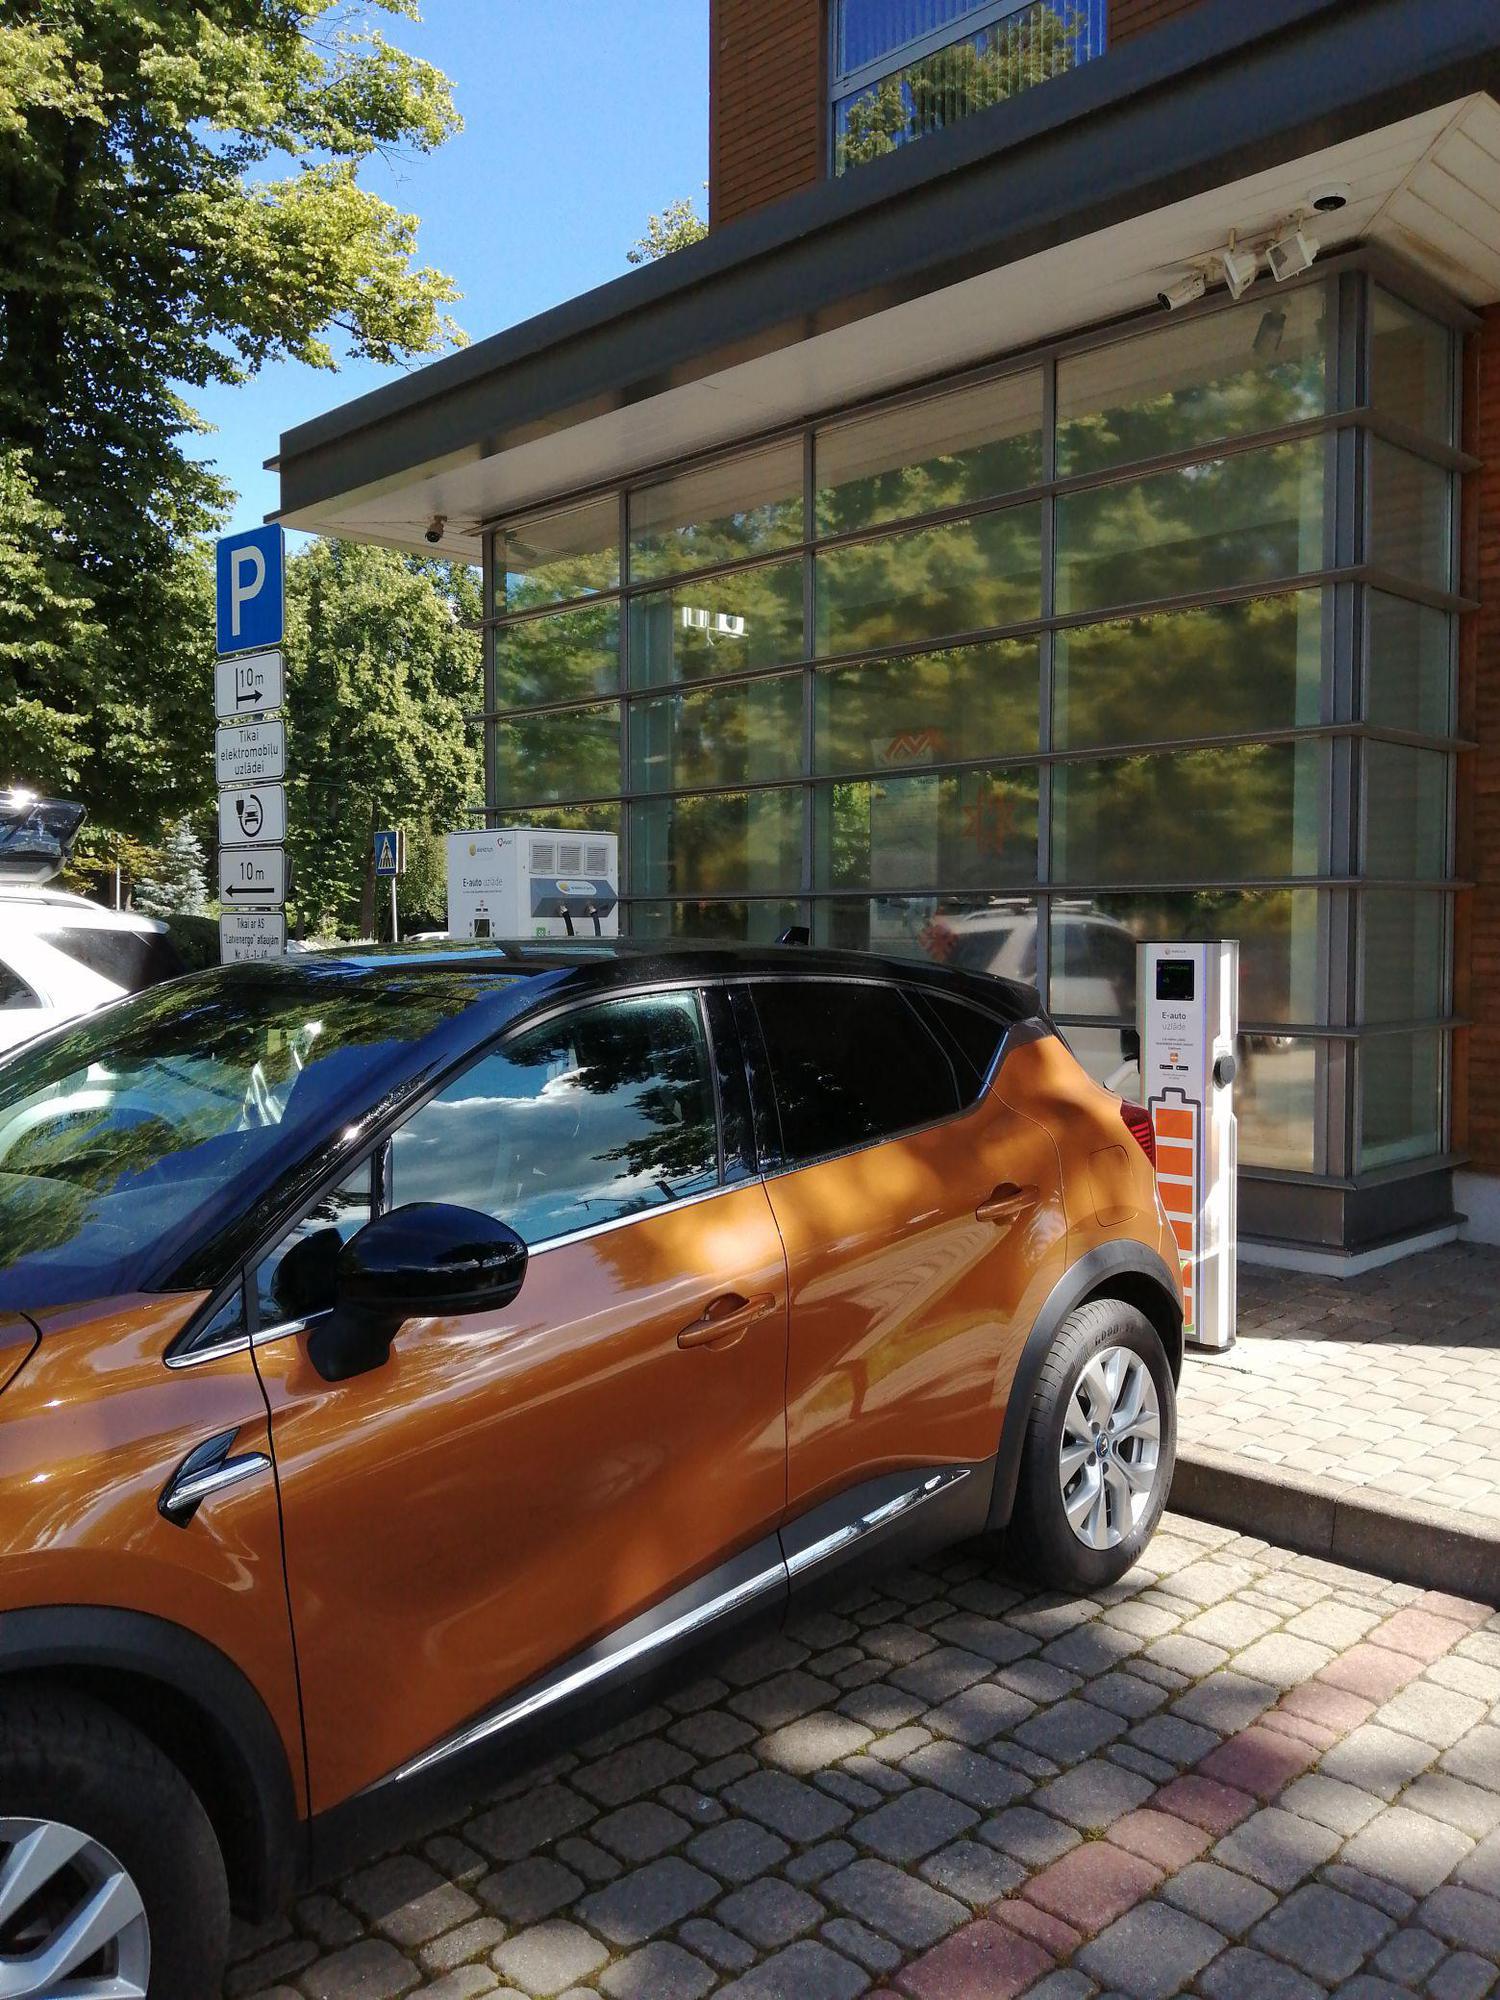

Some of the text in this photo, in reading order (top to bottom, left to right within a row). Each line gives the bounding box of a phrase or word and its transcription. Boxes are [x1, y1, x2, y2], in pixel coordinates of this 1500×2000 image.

[231, 545, 266, 637] P
[239, 728, 259, 743] Tikai
[234, 760, 265, 775] uzlādei
[462, 878, 483, 888] E-auto
[237, 917, 250, 929] Tikai
[257, 917, 265, 929] AS
[1161, 1011, 1187, 1020] E-auto
